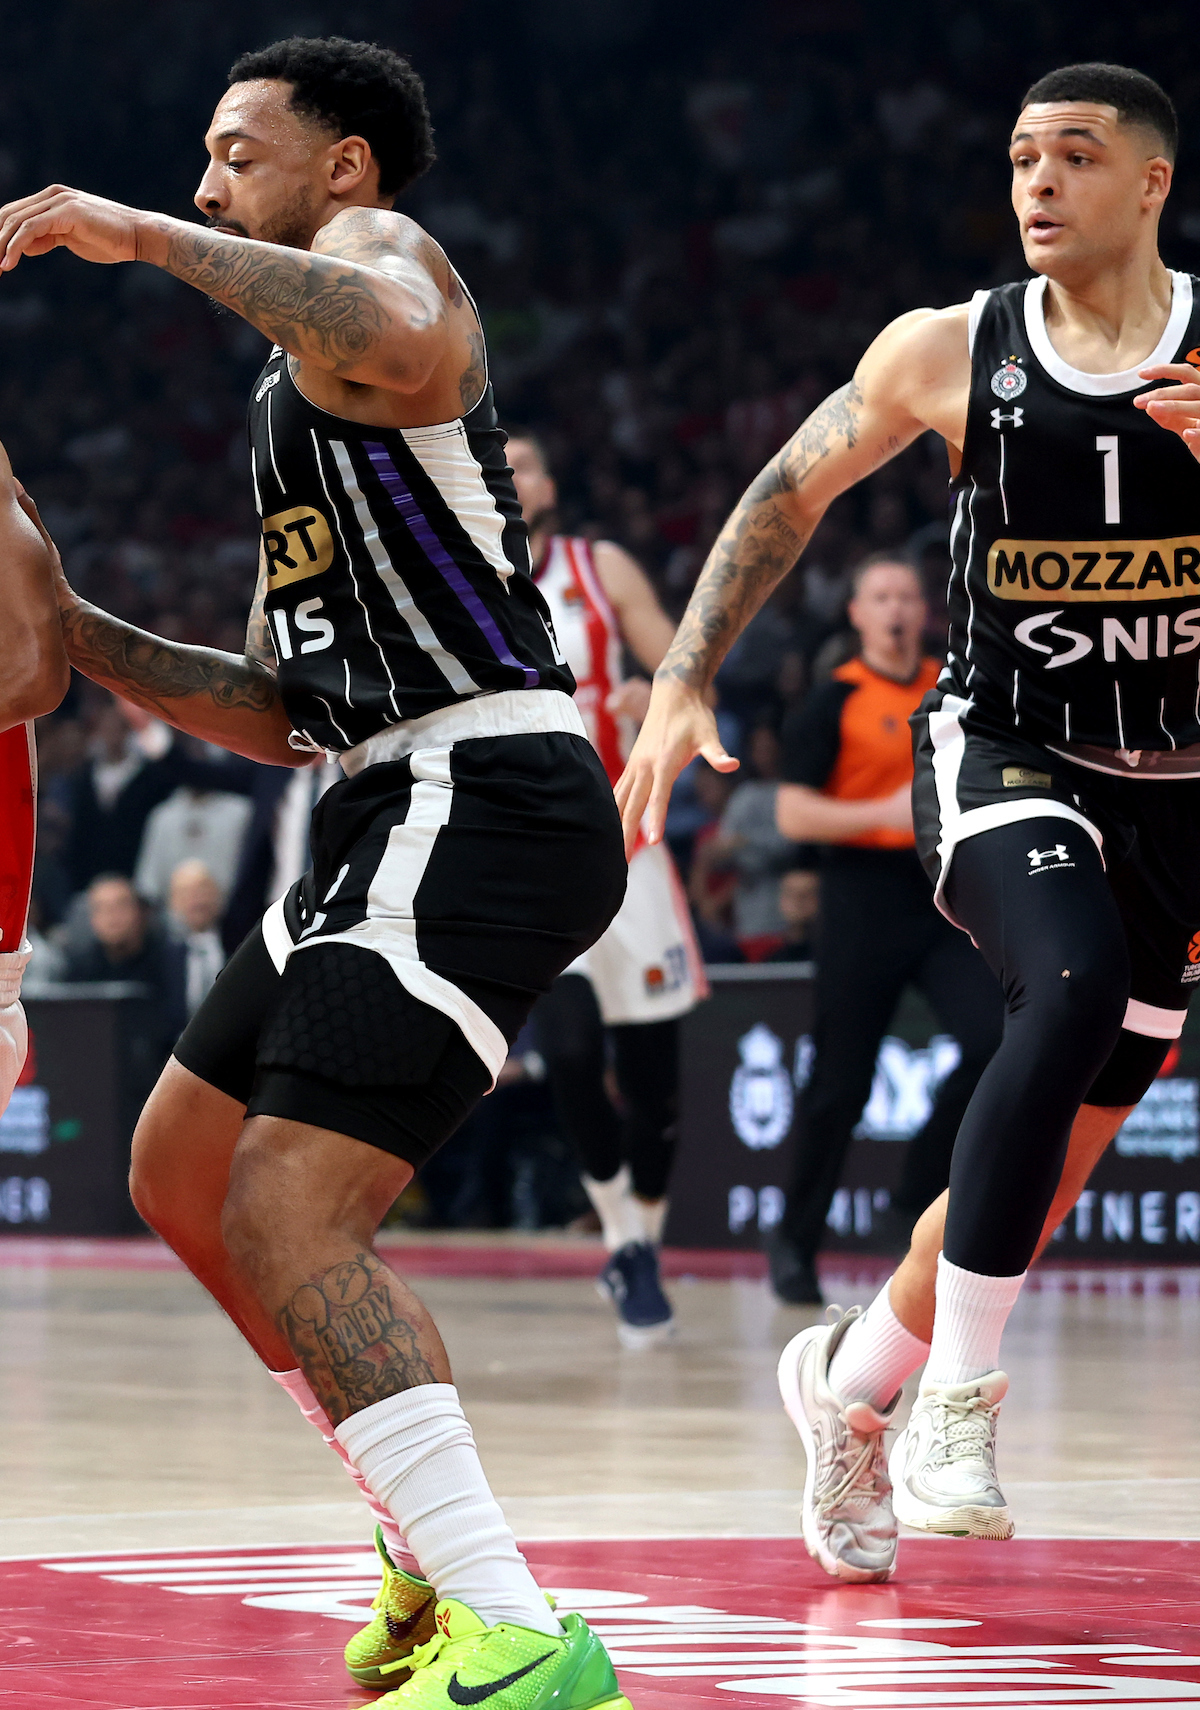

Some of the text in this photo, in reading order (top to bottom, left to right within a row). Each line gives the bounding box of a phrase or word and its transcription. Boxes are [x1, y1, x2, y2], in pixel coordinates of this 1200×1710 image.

[1096, 435, 1120, 524] 1
[994, 547, 1200, 591] MOZZAR
[1102, 608, 1200, 663] NIS
[1028, 862, 1076, 876] UNDER ARMOUR
